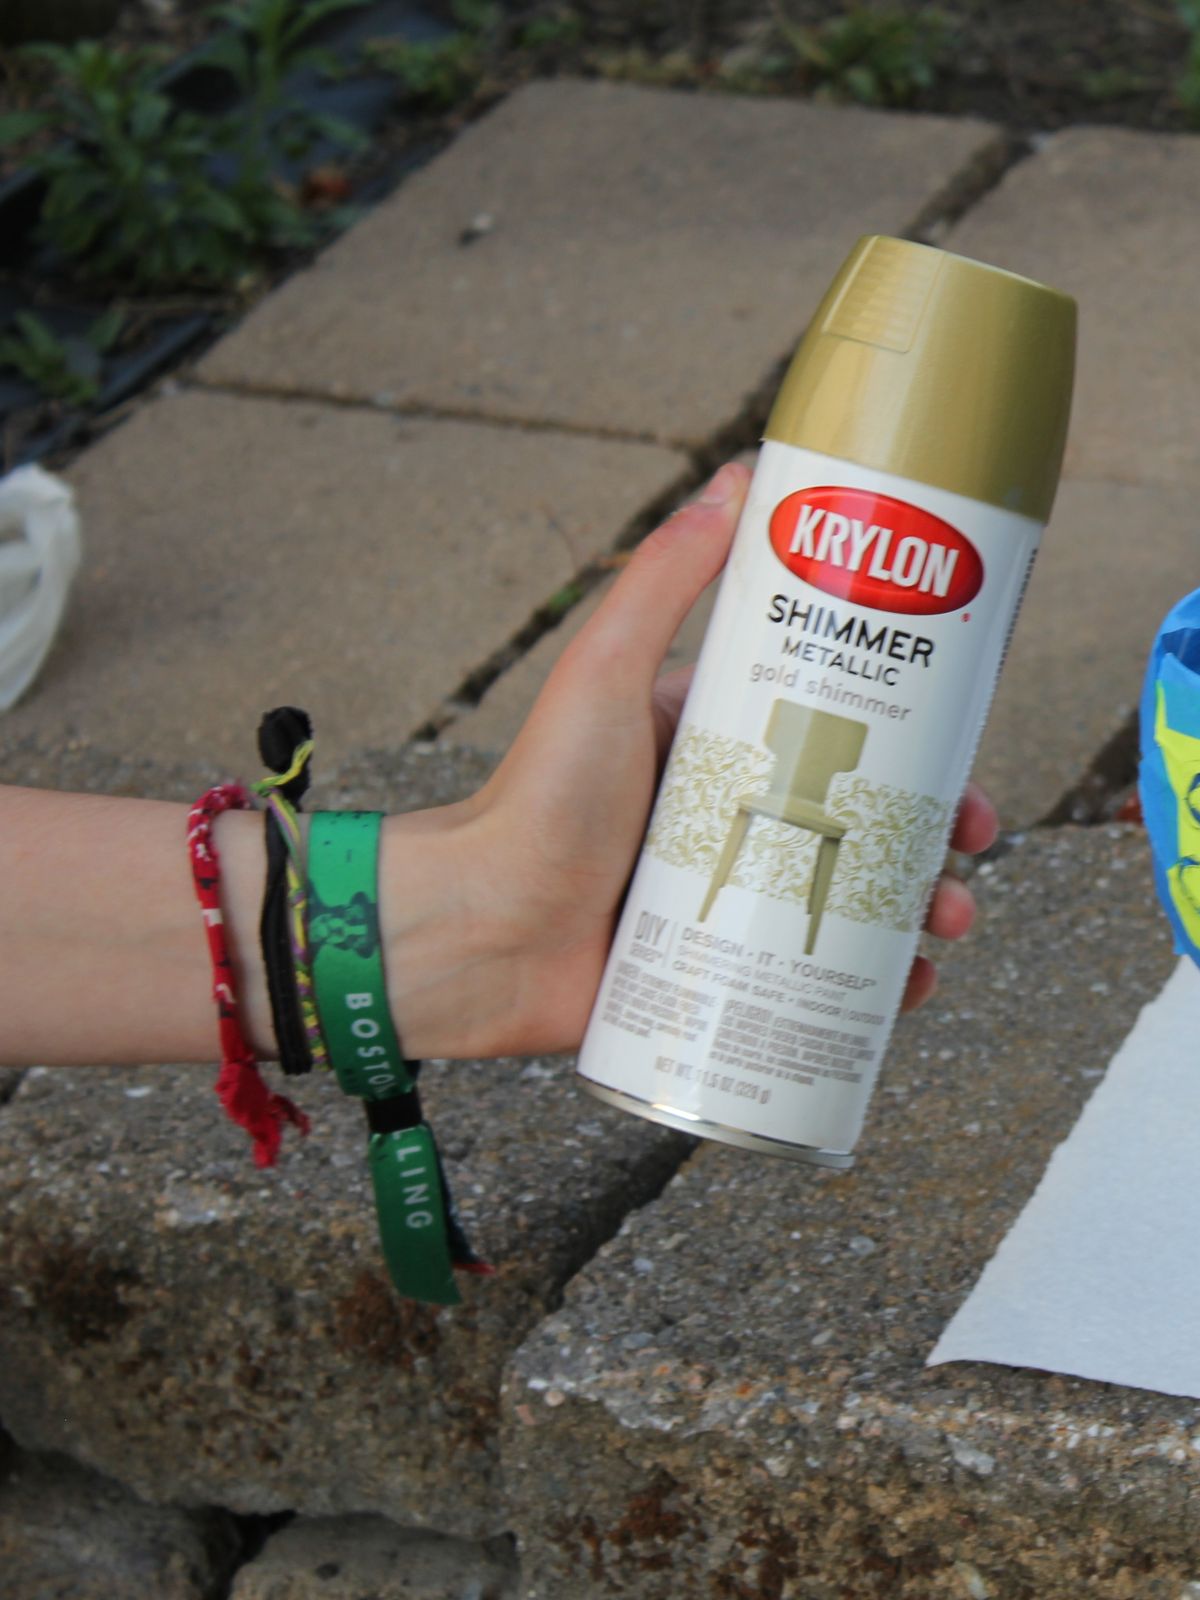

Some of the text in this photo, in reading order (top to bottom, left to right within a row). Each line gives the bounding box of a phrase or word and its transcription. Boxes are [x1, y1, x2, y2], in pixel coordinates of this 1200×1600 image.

[788, 503, 960, 598] KRYLON
[767, 594, 935, 668] SHIMMER
[781, 635, 901, 686] METALLIC
[750, 661, 912, 721] gold shimmer
[633, 910, 669, 947] DIY
[682, 927, 744, 958] DESIGN
[756, 951, 776, 967] IT
[672, 959, 710, 981] CRAFT
[752, 985, 786, 1003] SAFE
[754, 970, 811, 994] METALLIC
